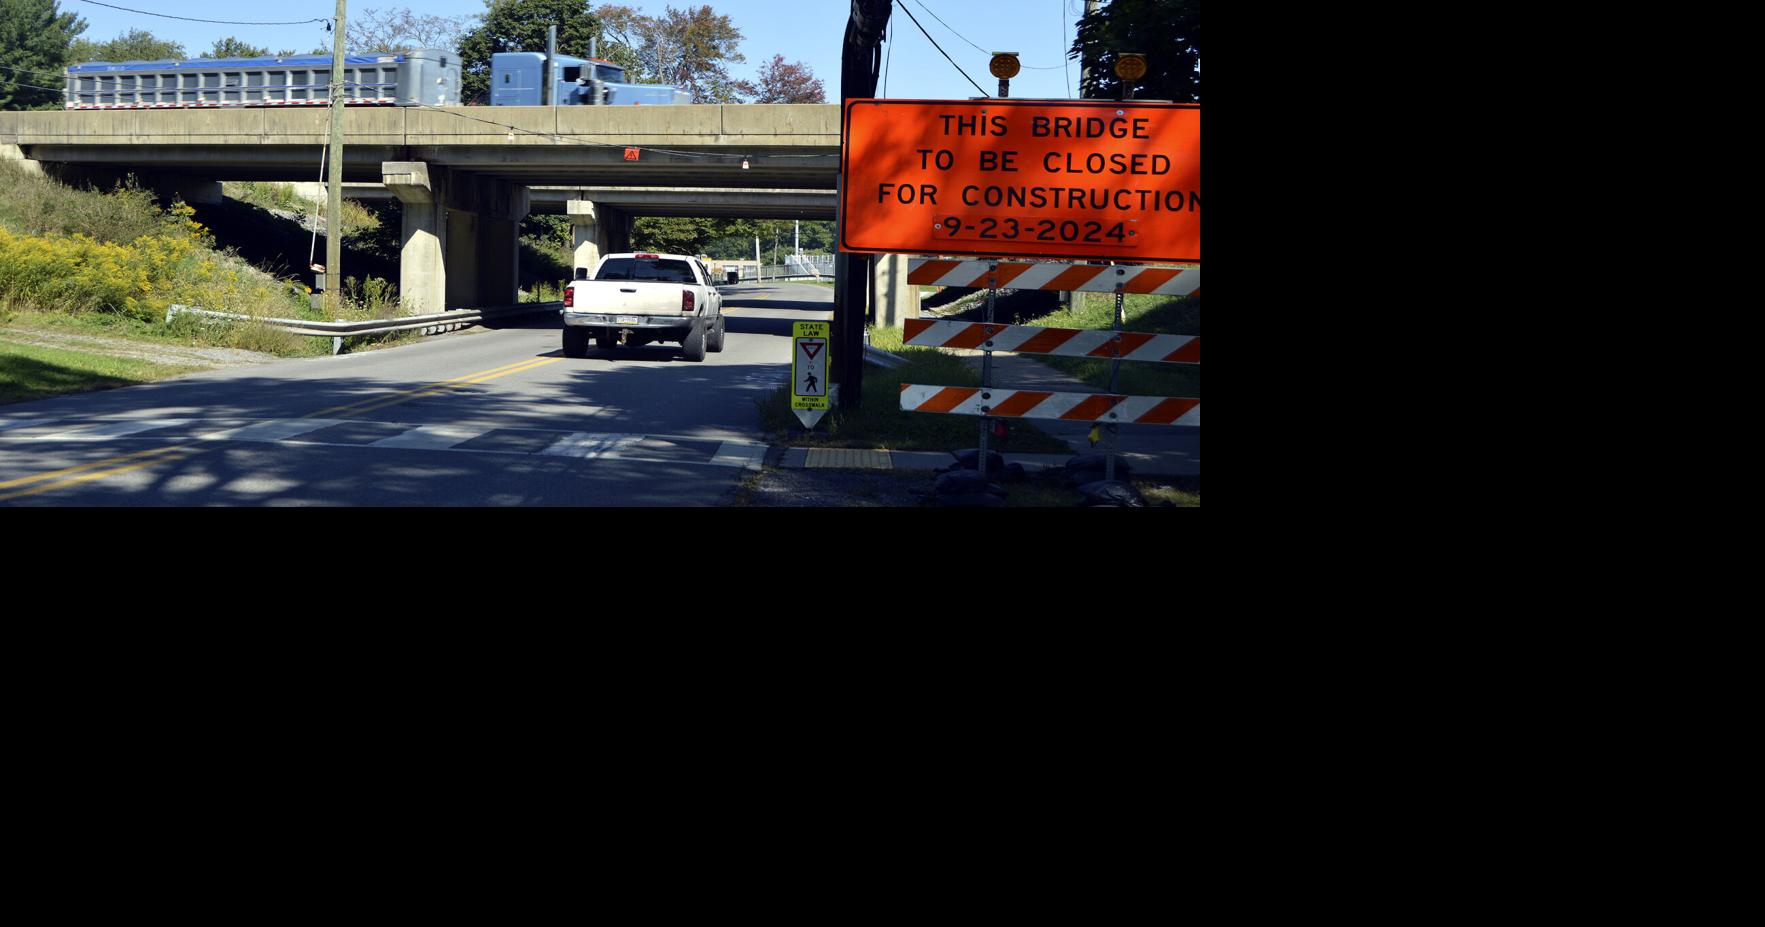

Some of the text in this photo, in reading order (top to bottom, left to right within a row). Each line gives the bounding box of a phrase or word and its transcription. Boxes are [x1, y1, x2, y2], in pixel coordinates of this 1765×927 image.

[939, 114, 1150, 140] THIS BRIDGE
[916, 149, 1171, 176] TO BE CLOSED
[877, 183, 938, 206] FOR
[943, 216, 1126, 243] 9-23-2024
